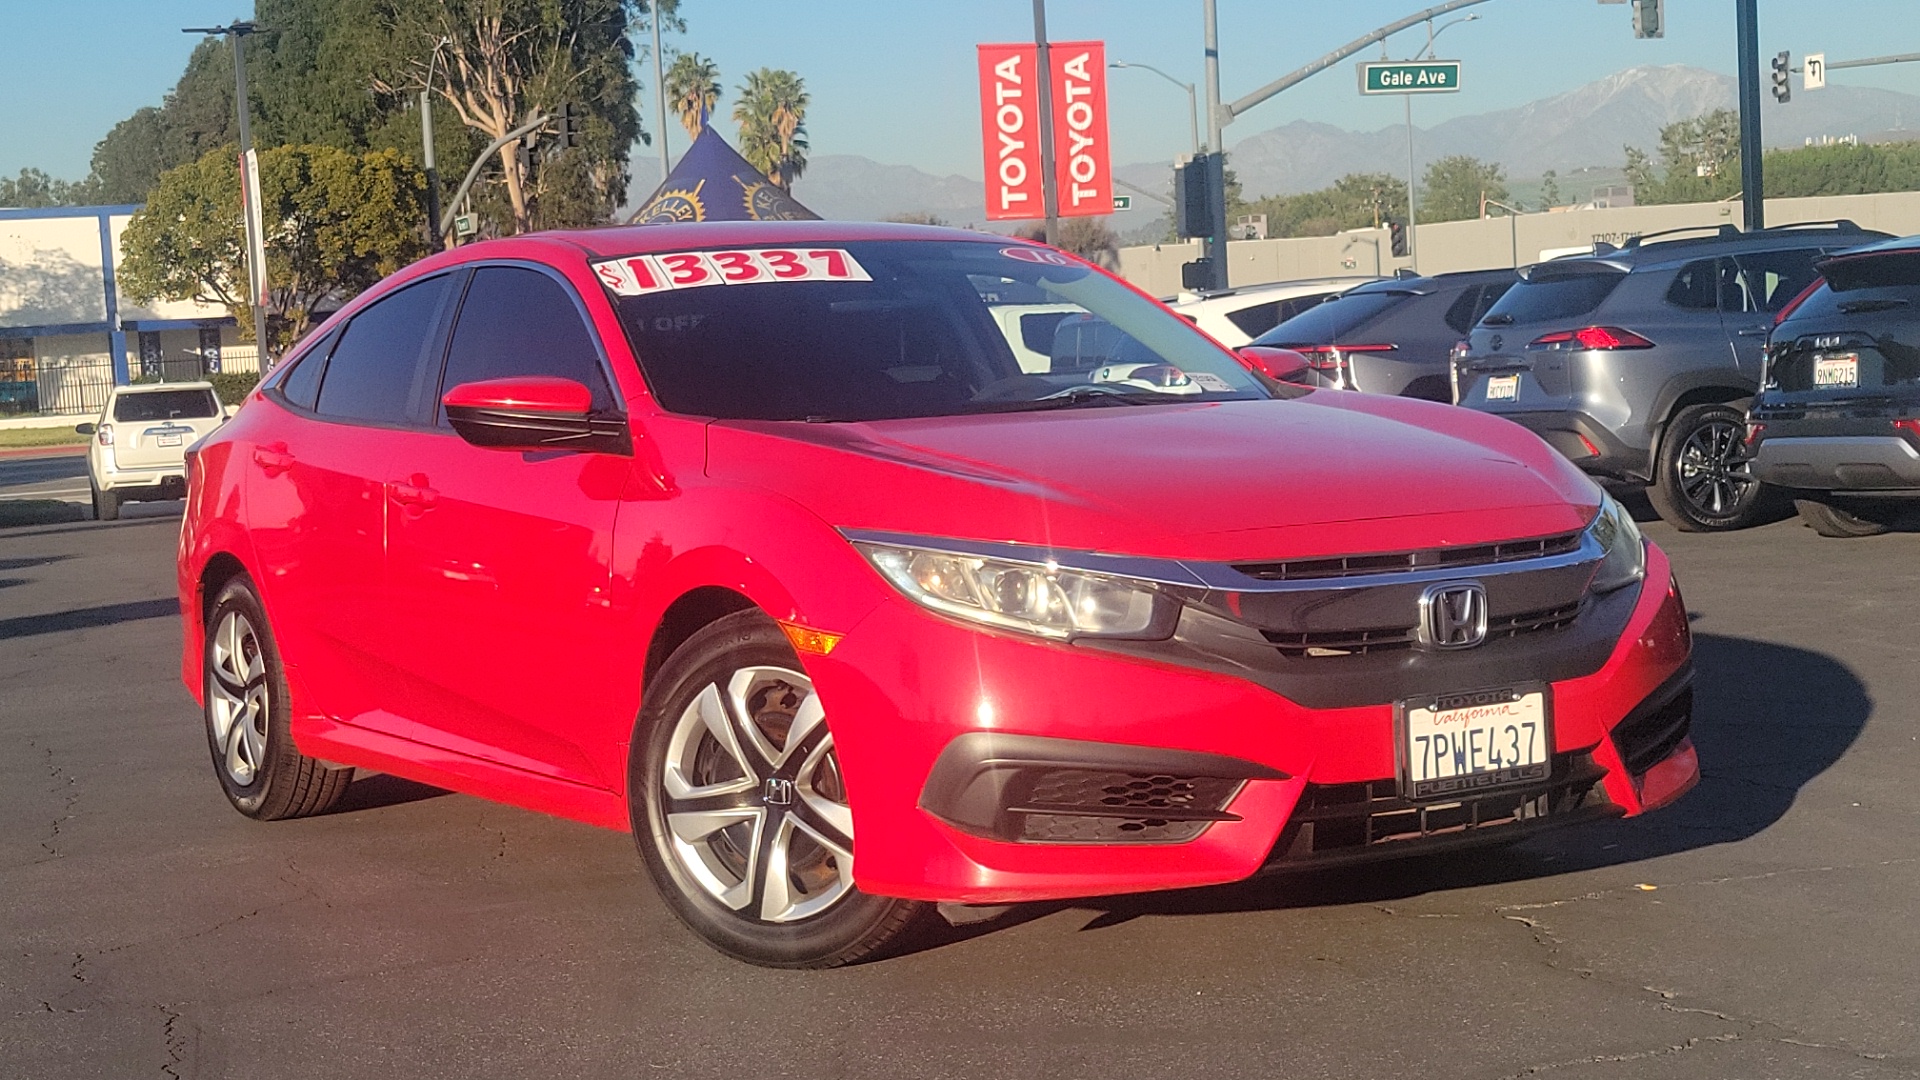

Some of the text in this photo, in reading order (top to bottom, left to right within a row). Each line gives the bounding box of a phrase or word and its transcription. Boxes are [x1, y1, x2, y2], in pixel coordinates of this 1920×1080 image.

[1380, 68, 1446, 86] Gale Ave
[995, 55, 1028, 210] TOYOTA
[1064, 52, 1097, 207] TOYOTA
[639, 199, 693, 224] KELLEY
[1817, 367, 1855, 384] 9NMG215
[1439, 689, 1512, 708] TOYOTA
[1433, 705, 1519, 728] California
[1415, 722, 1536, 780] 7PWE437
[1491, 764, 1544, 784] HILLS
